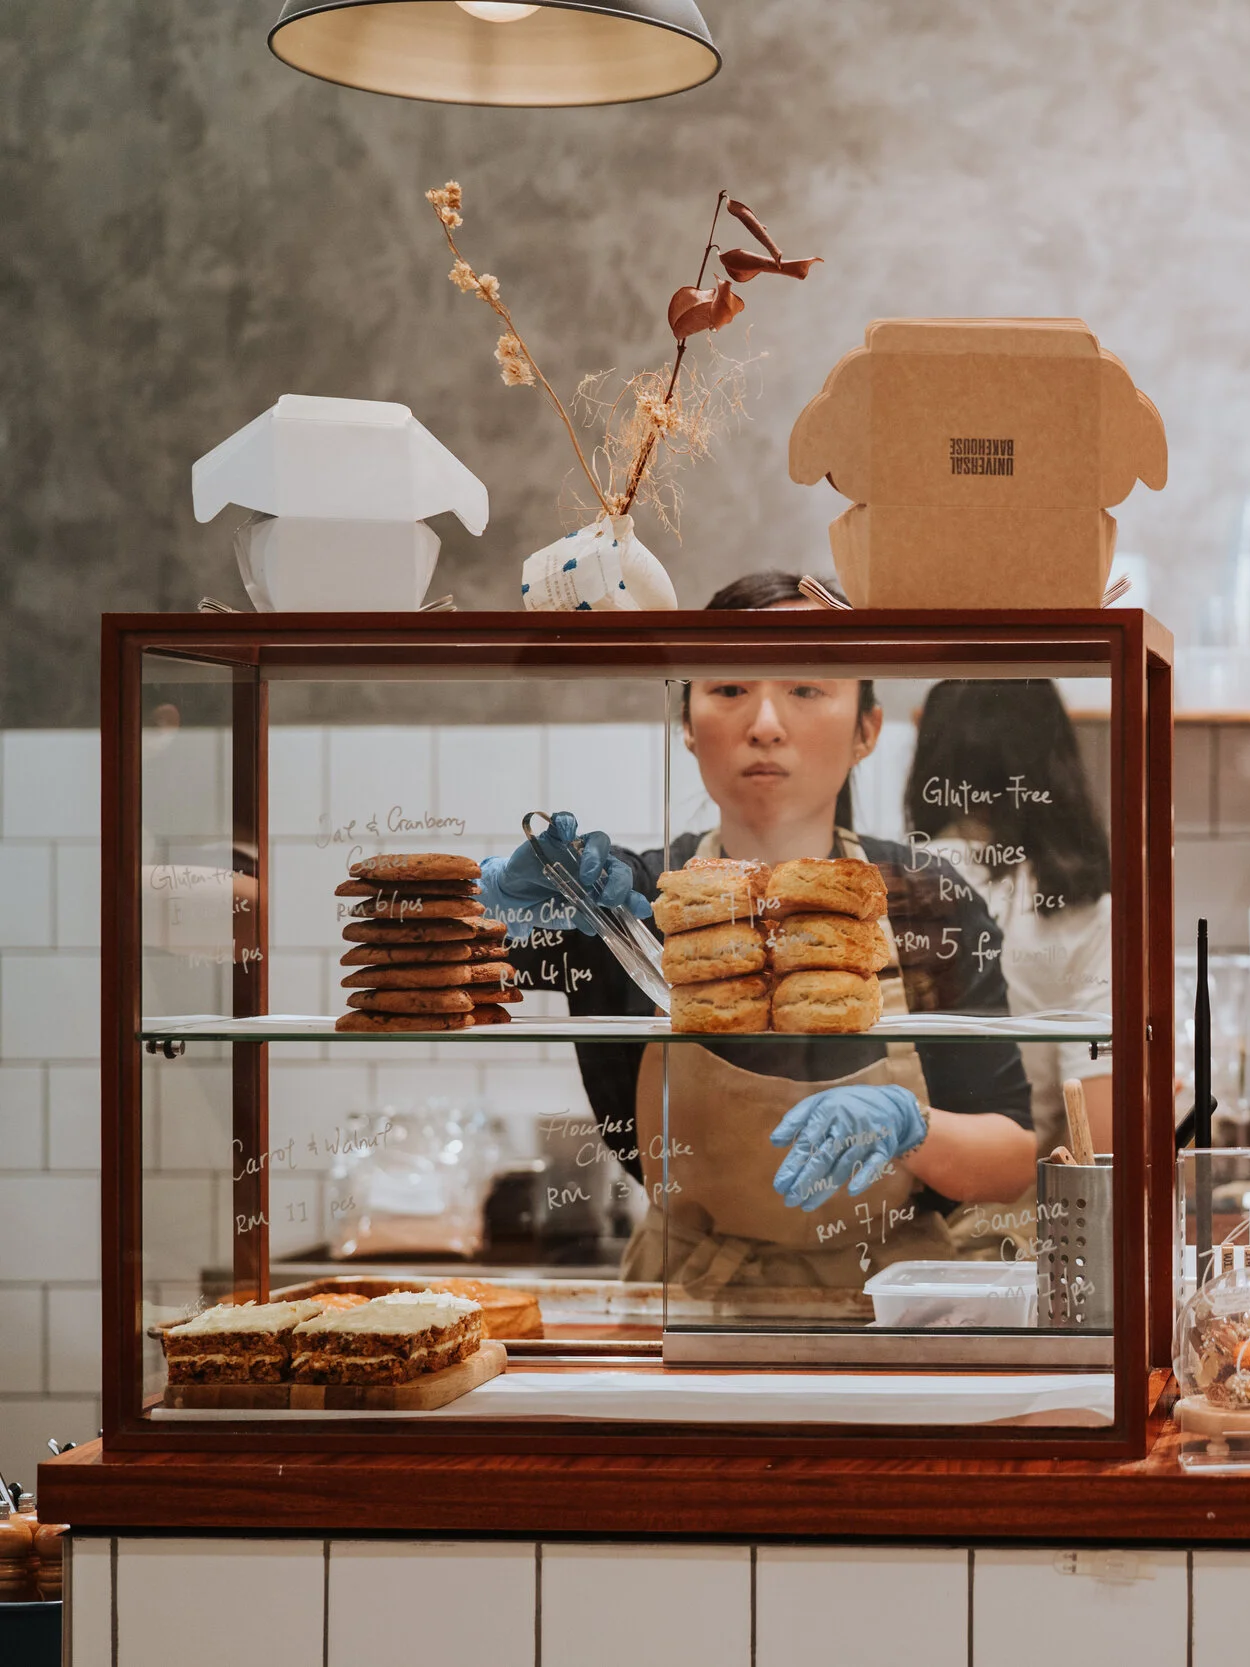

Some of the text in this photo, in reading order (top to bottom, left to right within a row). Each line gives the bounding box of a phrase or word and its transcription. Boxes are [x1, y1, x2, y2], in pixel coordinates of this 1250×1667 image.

[950, 438, 1014, 456] BAKEHOUSE
[950, 457, 1014, 476] UNIVERSAL
[387, 806, 465, 836] Cranberry
[903, 830, 1027, 873] Brownies
[540, 898, 577, 929] Chip
[936, 928, 962, 960] 5
[971, 931, 1001, 973] for
[538, 1108, 635, 1140] Flourless
[229, 1138, 297, 1181] Carrot
[325, 1122, 393, 1155] Walnut
[963, 1202, 1069, 1238] Banana
[1000, 1236, 1058, 1266] Cake
